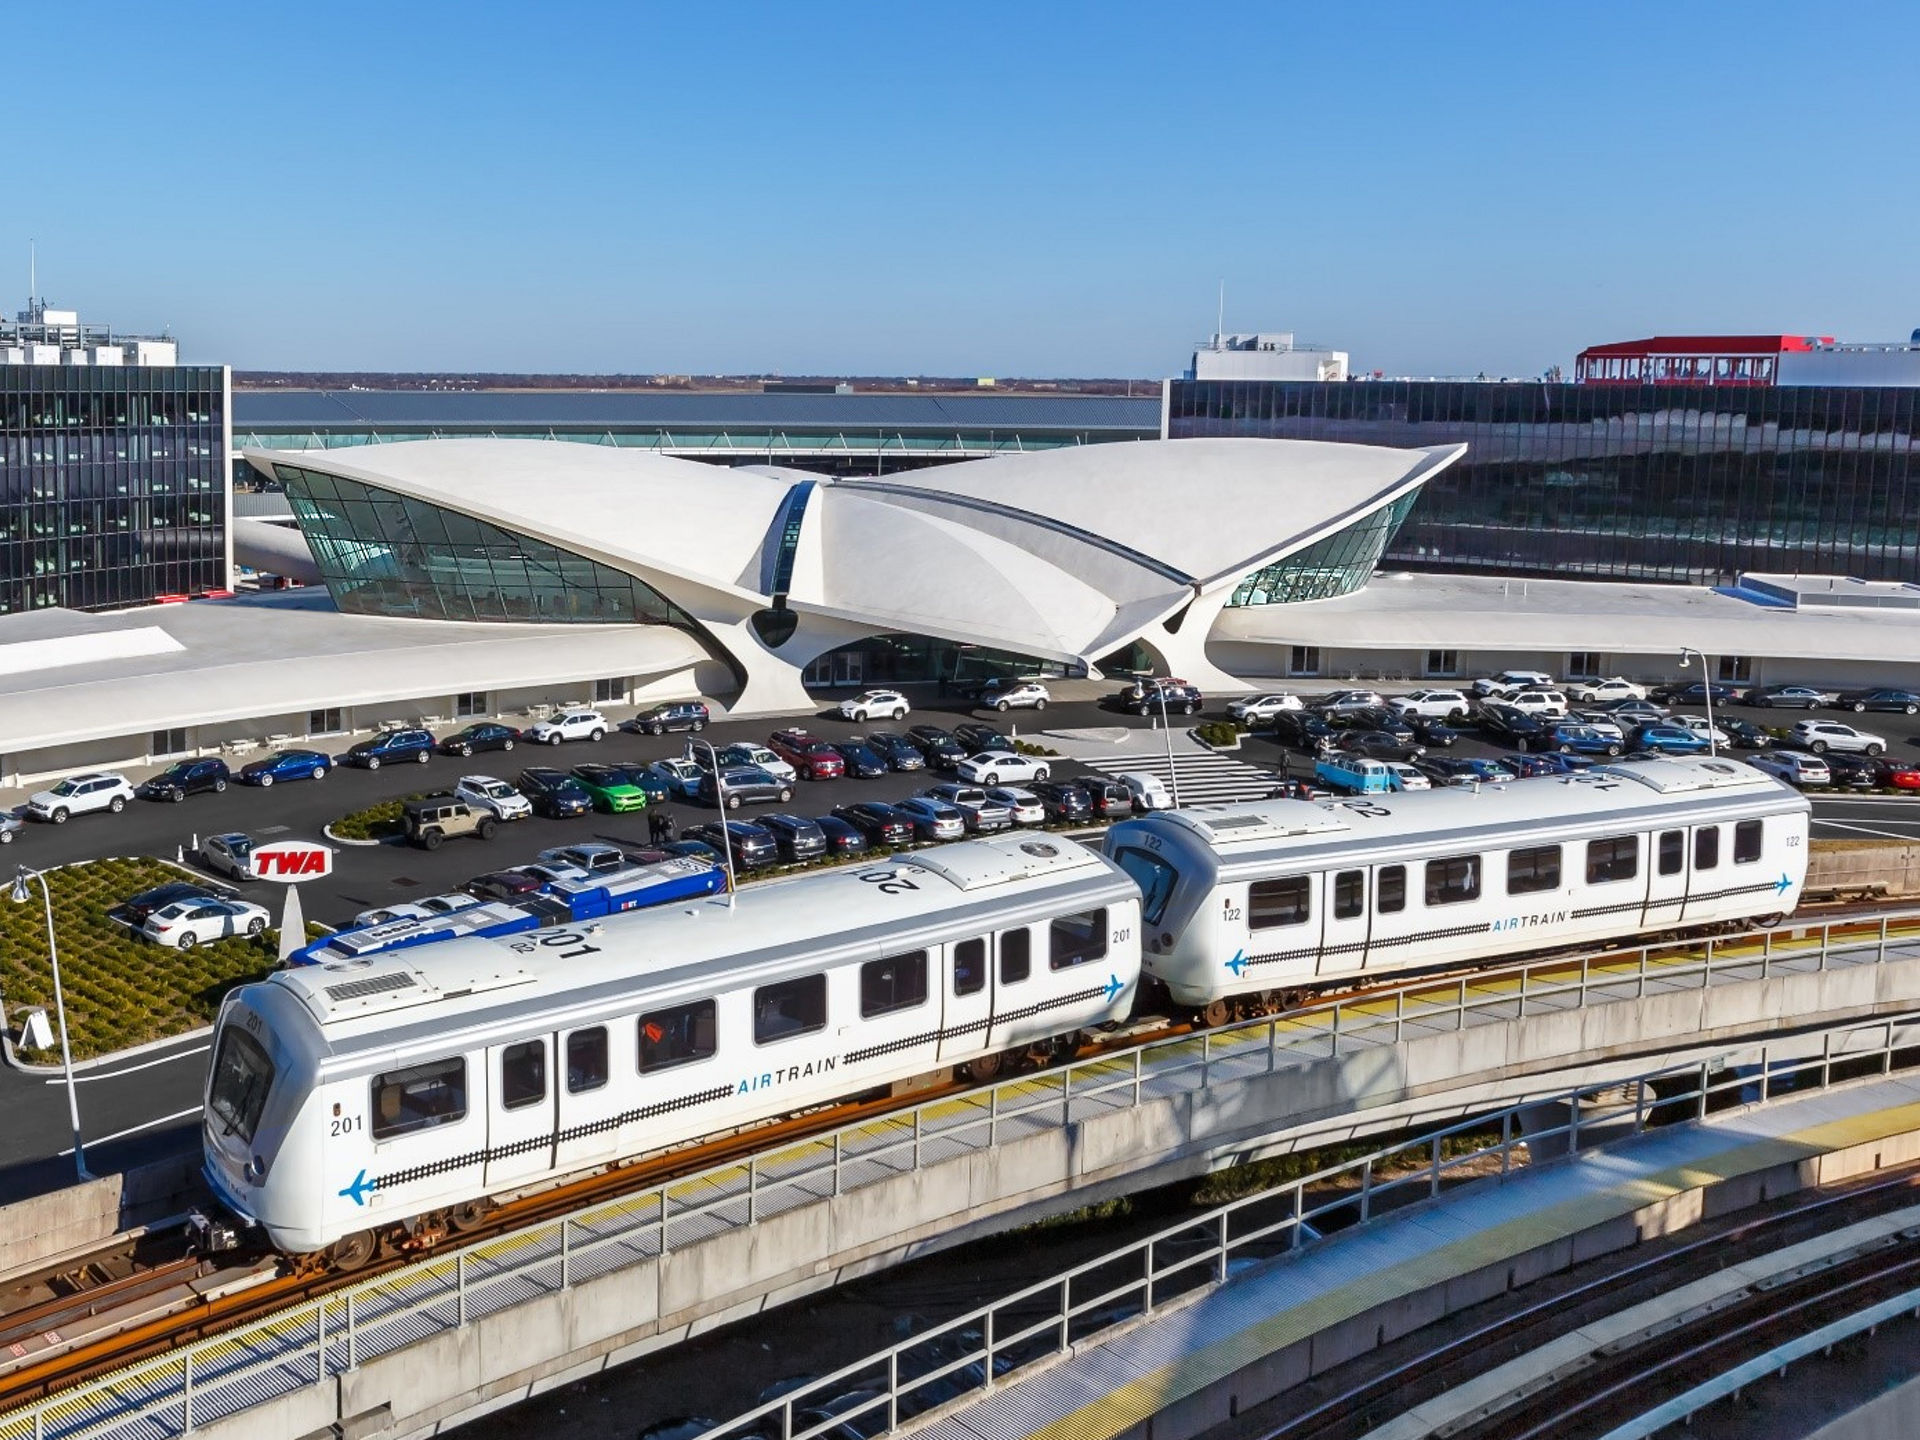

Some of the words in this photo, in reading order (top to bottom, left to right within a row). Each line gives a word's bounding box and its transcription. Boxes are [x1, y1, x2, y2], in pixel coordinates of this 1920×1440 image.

[1144, 833, 1162, 852] 122
[1786, 836, 1800, 847] 122
[255, 851, 325, 875] TWA
[842, 867, 920, 894] 201
[1223, 908, 1241, 921] 122
[1492, 910, 1566, 933] AIRTRAIN
[1113, 928, 1130, 944] 201
[247, 1012, 263, 1034] 201
[737, 1056, 837, 1095] AIRTRAIN
[330, 1115, 363, 1137] 201
